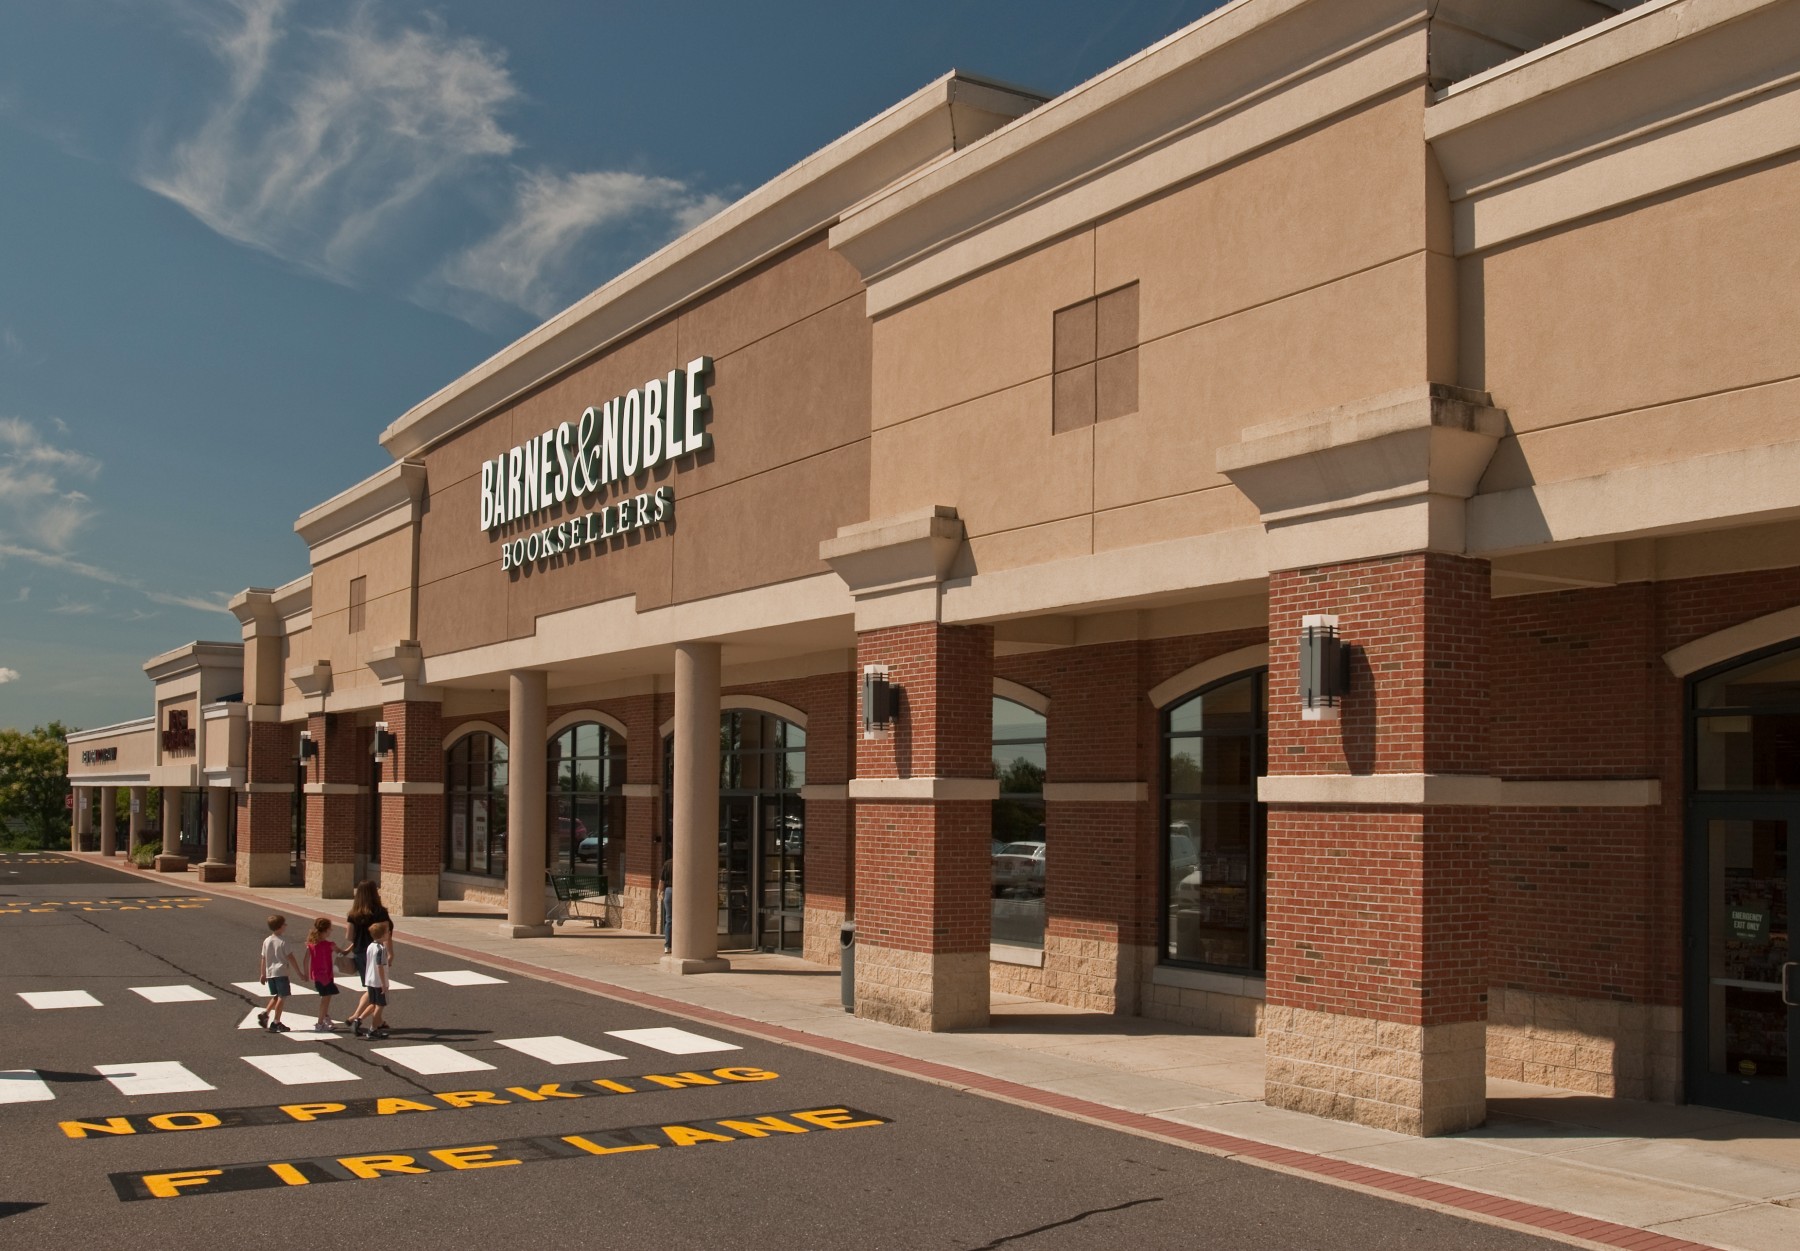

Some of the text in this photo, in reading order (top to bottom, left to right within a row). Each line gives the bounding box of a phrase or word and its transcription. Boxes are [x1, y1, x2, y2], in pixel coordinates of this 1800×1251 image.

[501, 486, 673, 571] BOOKSELLERS
[1732, 911, 1762, 922] EMERGENCY
[1733, 920, 1760, 931] EXIT ONLY
[58, 1066, 780, 1139] NO PARKING
[142, 1108, 885, 1199] FIRE LANE
